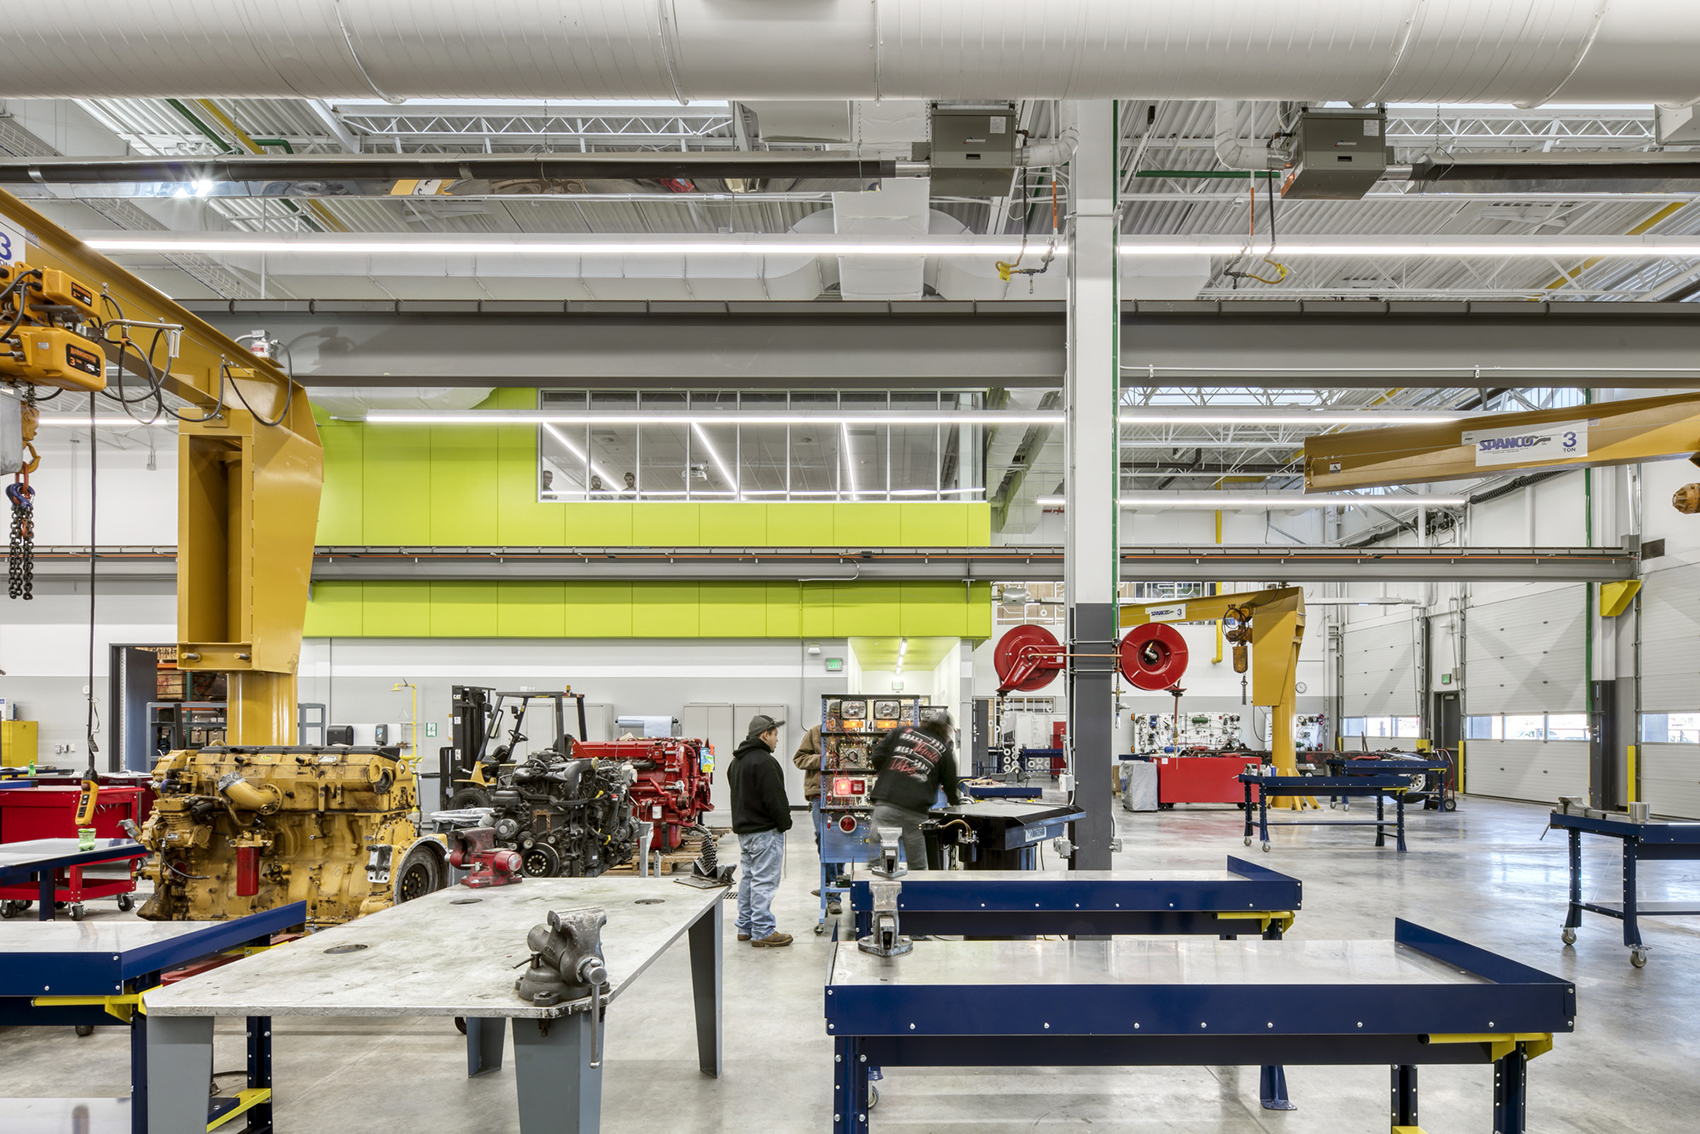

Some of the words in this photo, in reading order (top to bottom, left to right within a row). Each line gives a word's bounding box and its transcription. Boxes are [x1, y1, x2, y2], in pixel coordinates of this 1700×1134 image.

[1479, 435, 1534, 451] SPANCO
[1562, 431, 1578, 448] 3
[1177, 608, 1182, 616] 3
[828, 658, 841, 669] EXIT
[868, 721, 873, 732] 4
